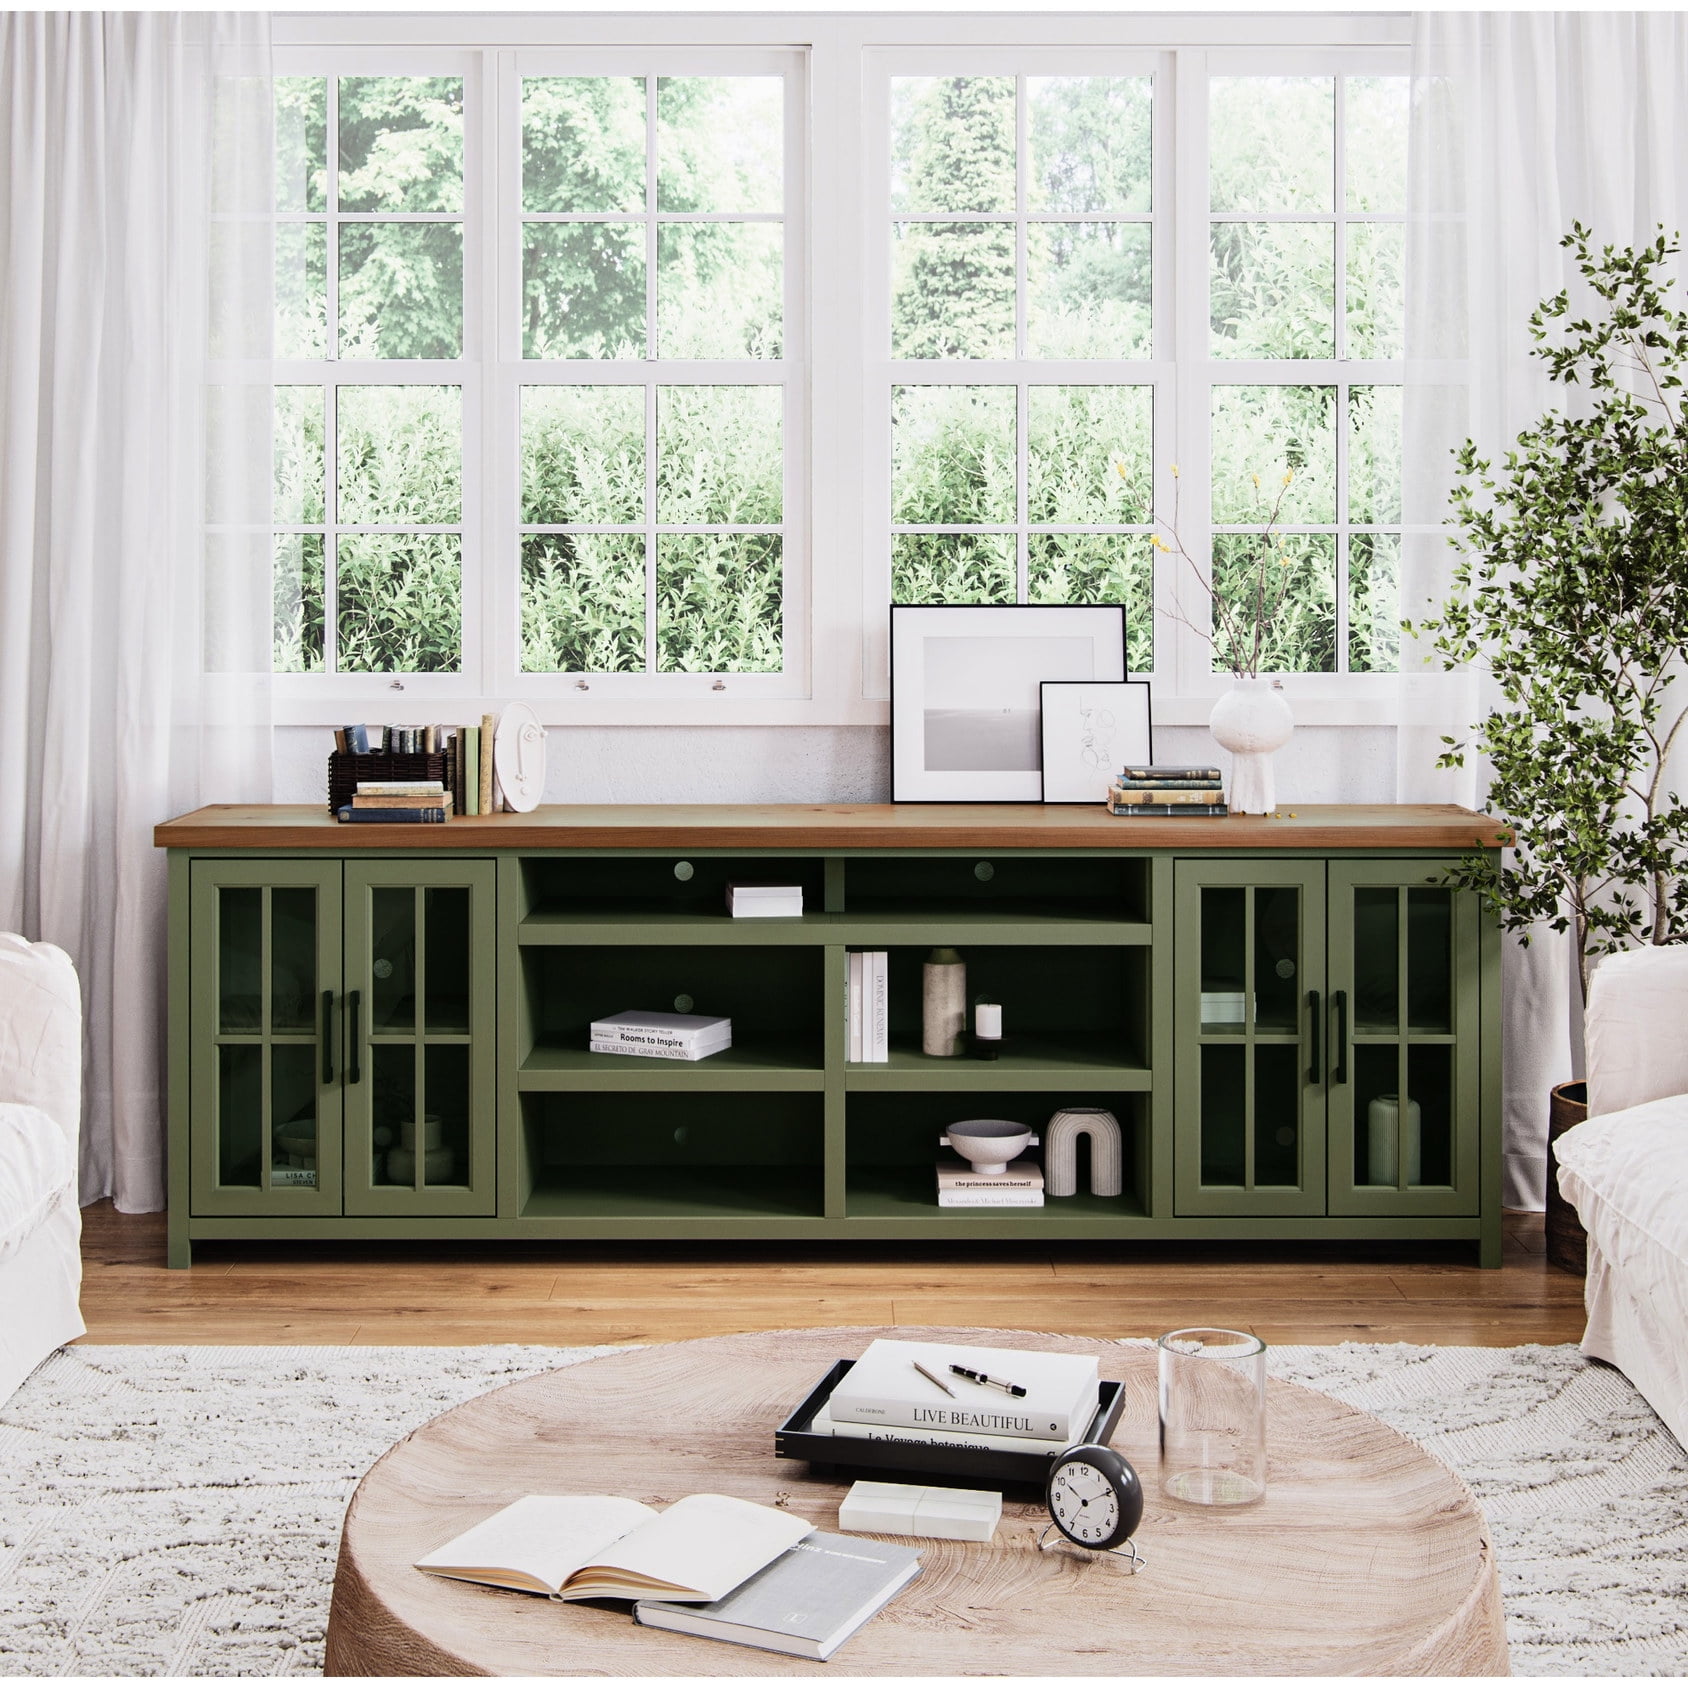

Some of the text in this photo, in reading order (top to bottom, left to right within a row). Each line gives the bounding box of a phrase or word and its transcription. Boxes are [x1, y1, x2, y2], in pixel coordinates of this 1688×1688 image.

[620, 1033, 645, 1043] Rooms
[647, 1036, 655, 1044] to
[657, 1038, 683, 1048] Inspire
[602, 1044, 627, 1053] SECRETO
[655, 1048, 689, 1058] MOUNTAIN
[855, 1407, 886, 1415] CALDERONE
[913, 1408, 948, 1425] LIVE
[950, 1410, 1034, 1432] BEAUTIFUL
[1068, 1467, 1075, 1476] 11
[1080, 1466, 1089, 1476] 12
[1057, 1477, 1066, 1486] 10
[1055, 1492, 1061, 1501] 9
[1059, 1508, 1065, 1517] 8
[1109, 1504, 1115, 1513] 3
[1069, 1521, 1075, 1531] 7
[1105, 1518, 1111, 1527] 4
[1082, 1528, 1088, 1538] 6
[1095, 1528, 1101, 1537] 5
